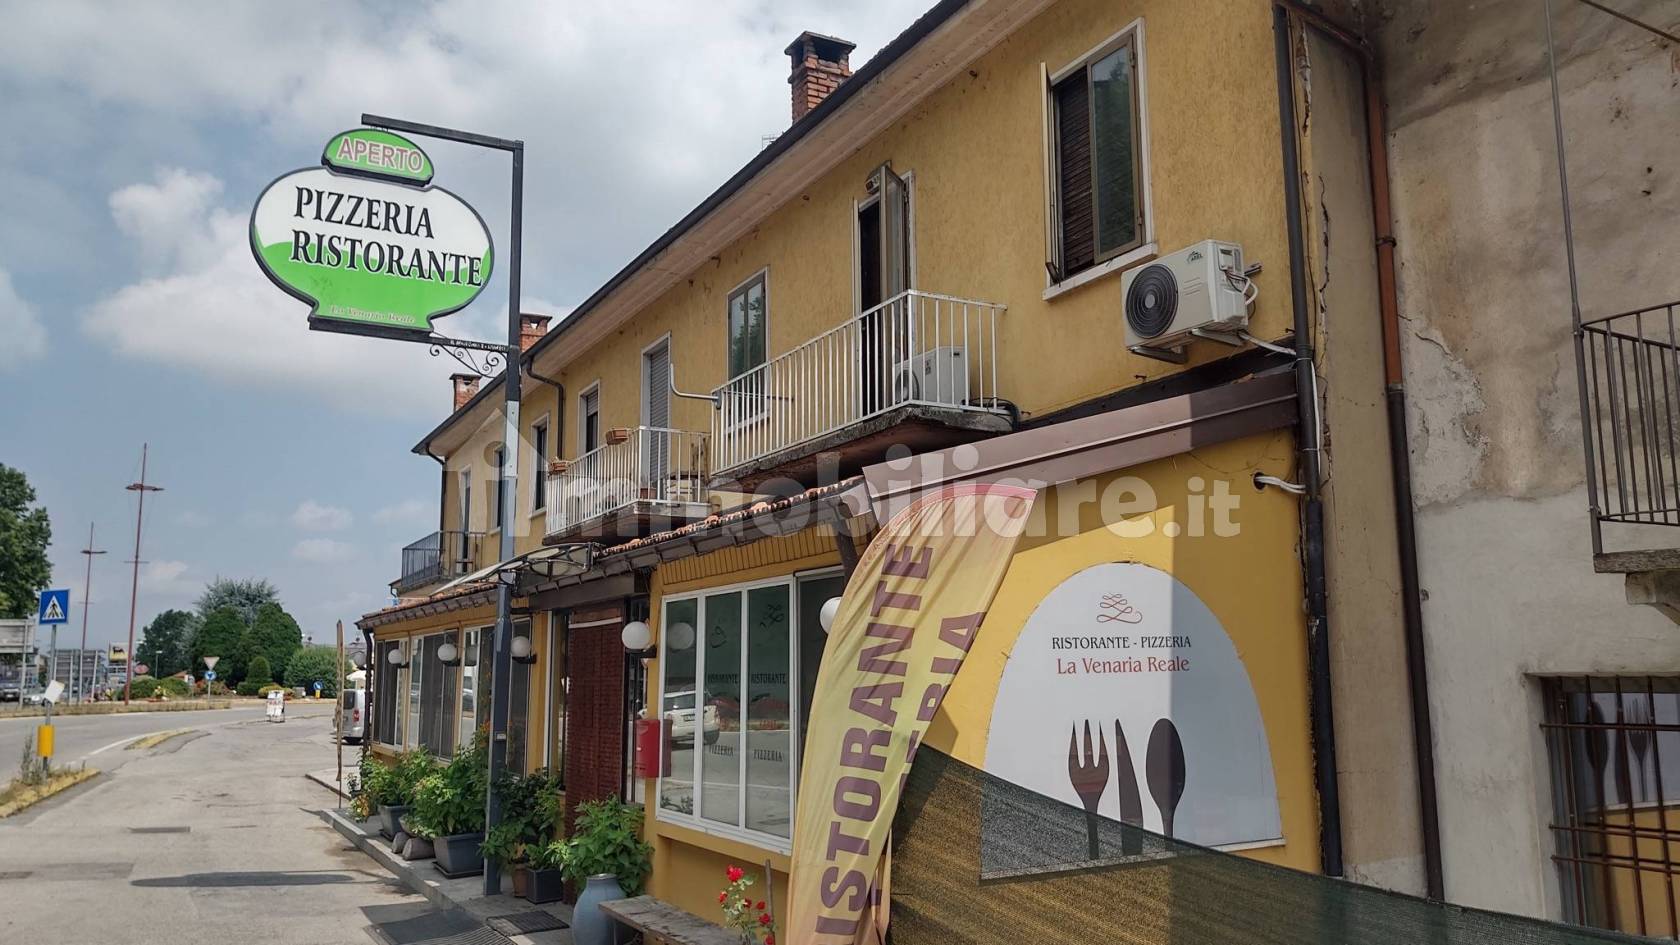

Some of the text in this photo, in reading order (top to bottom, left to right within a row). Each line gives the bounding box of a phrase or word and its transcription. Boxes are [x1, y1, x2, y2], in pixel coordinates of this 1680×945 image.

[337, 137, 424, 172] APERTO
[293, 186, 435, 240] PIZZERIA
[291, 229, 483, 287] RISTORANTE
[1052, 636, 1131, 650] RISTORANTE
[1141, 635, 1192, 649] PIZZERIA
[1057, 655, 1190, 675] La Venaria Reale
[811, 543, 934, 945] ISTORANTE
